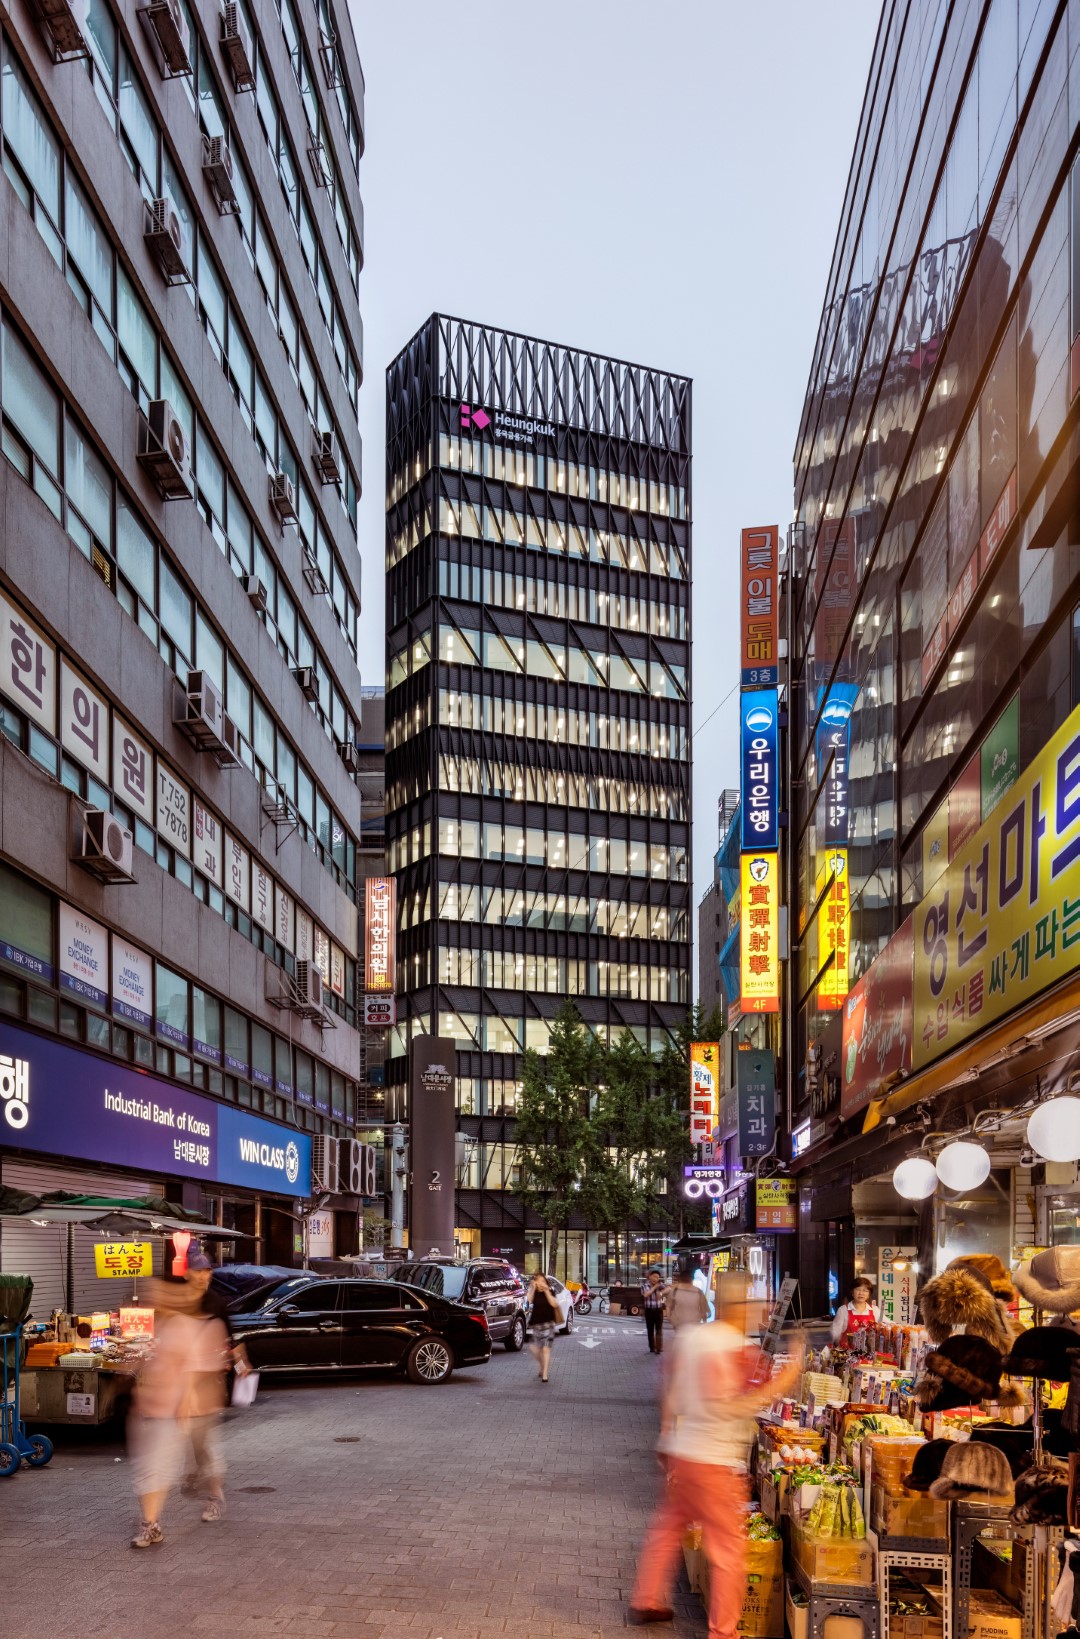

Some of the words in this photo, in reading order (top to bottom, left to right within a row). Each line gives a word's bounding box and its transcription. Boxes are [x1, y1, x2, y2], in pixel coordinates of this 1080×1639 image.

[495, 412, 555, 436] Heungkuk
[747, 532, 772, 570] 그릇
[747, 578, 772, 616] 이불
[747, 622, 772, 660] 도매
[750, 669, 771, 683] 3층
[10, 619, 146, 806] 한의원
[748, 738, 771, 833] 우리은행
[205, 809, 217, 877] 내과
[370, 895, 390, 973] 남시한의원
[749, 884, 771, 976] 實彈射擊
[13, 951, 25, 964] IBK
[73, 937, 94, 956] MONEY
[67, 946, 99, 972] EXCHANGE
[119, 975, 145, 997] EXCHANGE
[123, 967, 140, 983] MONEY
[922, 969, 984, 1049] 수입식품
[988, 931, 1030, 995] 싸게
[371, 1005, 387, 1013] 커피
[753, 999, 766, 1010] 4F
[693, 1070, 712, 1085] 황제
[104, 1088, 151, 1121] Industrial
[153, 1103, 175, 1128] Bank
[177, 1112, 187, 1130] of
[187, 1112, 210, 1137] Korea
[747, 1095, 768, 1137] 치과
[174, 1139, 209, 1167] 남대문시장
[240, 1137, 260, 1163] WIN
[260, 1144, 285, 1171] CLASS
[431, 1170, 441, 1184] 2
[104, 1243, 144, 1255] はんこ
[104, 1256, 144, 1269] 도장
[112, 1268, 141, 1276] STAMP
[124, 1316, 150, 1324] はんこ
[129, 1324, 145, 1333] 도장
[980, 1627, 1008, 1636] PUDDING
